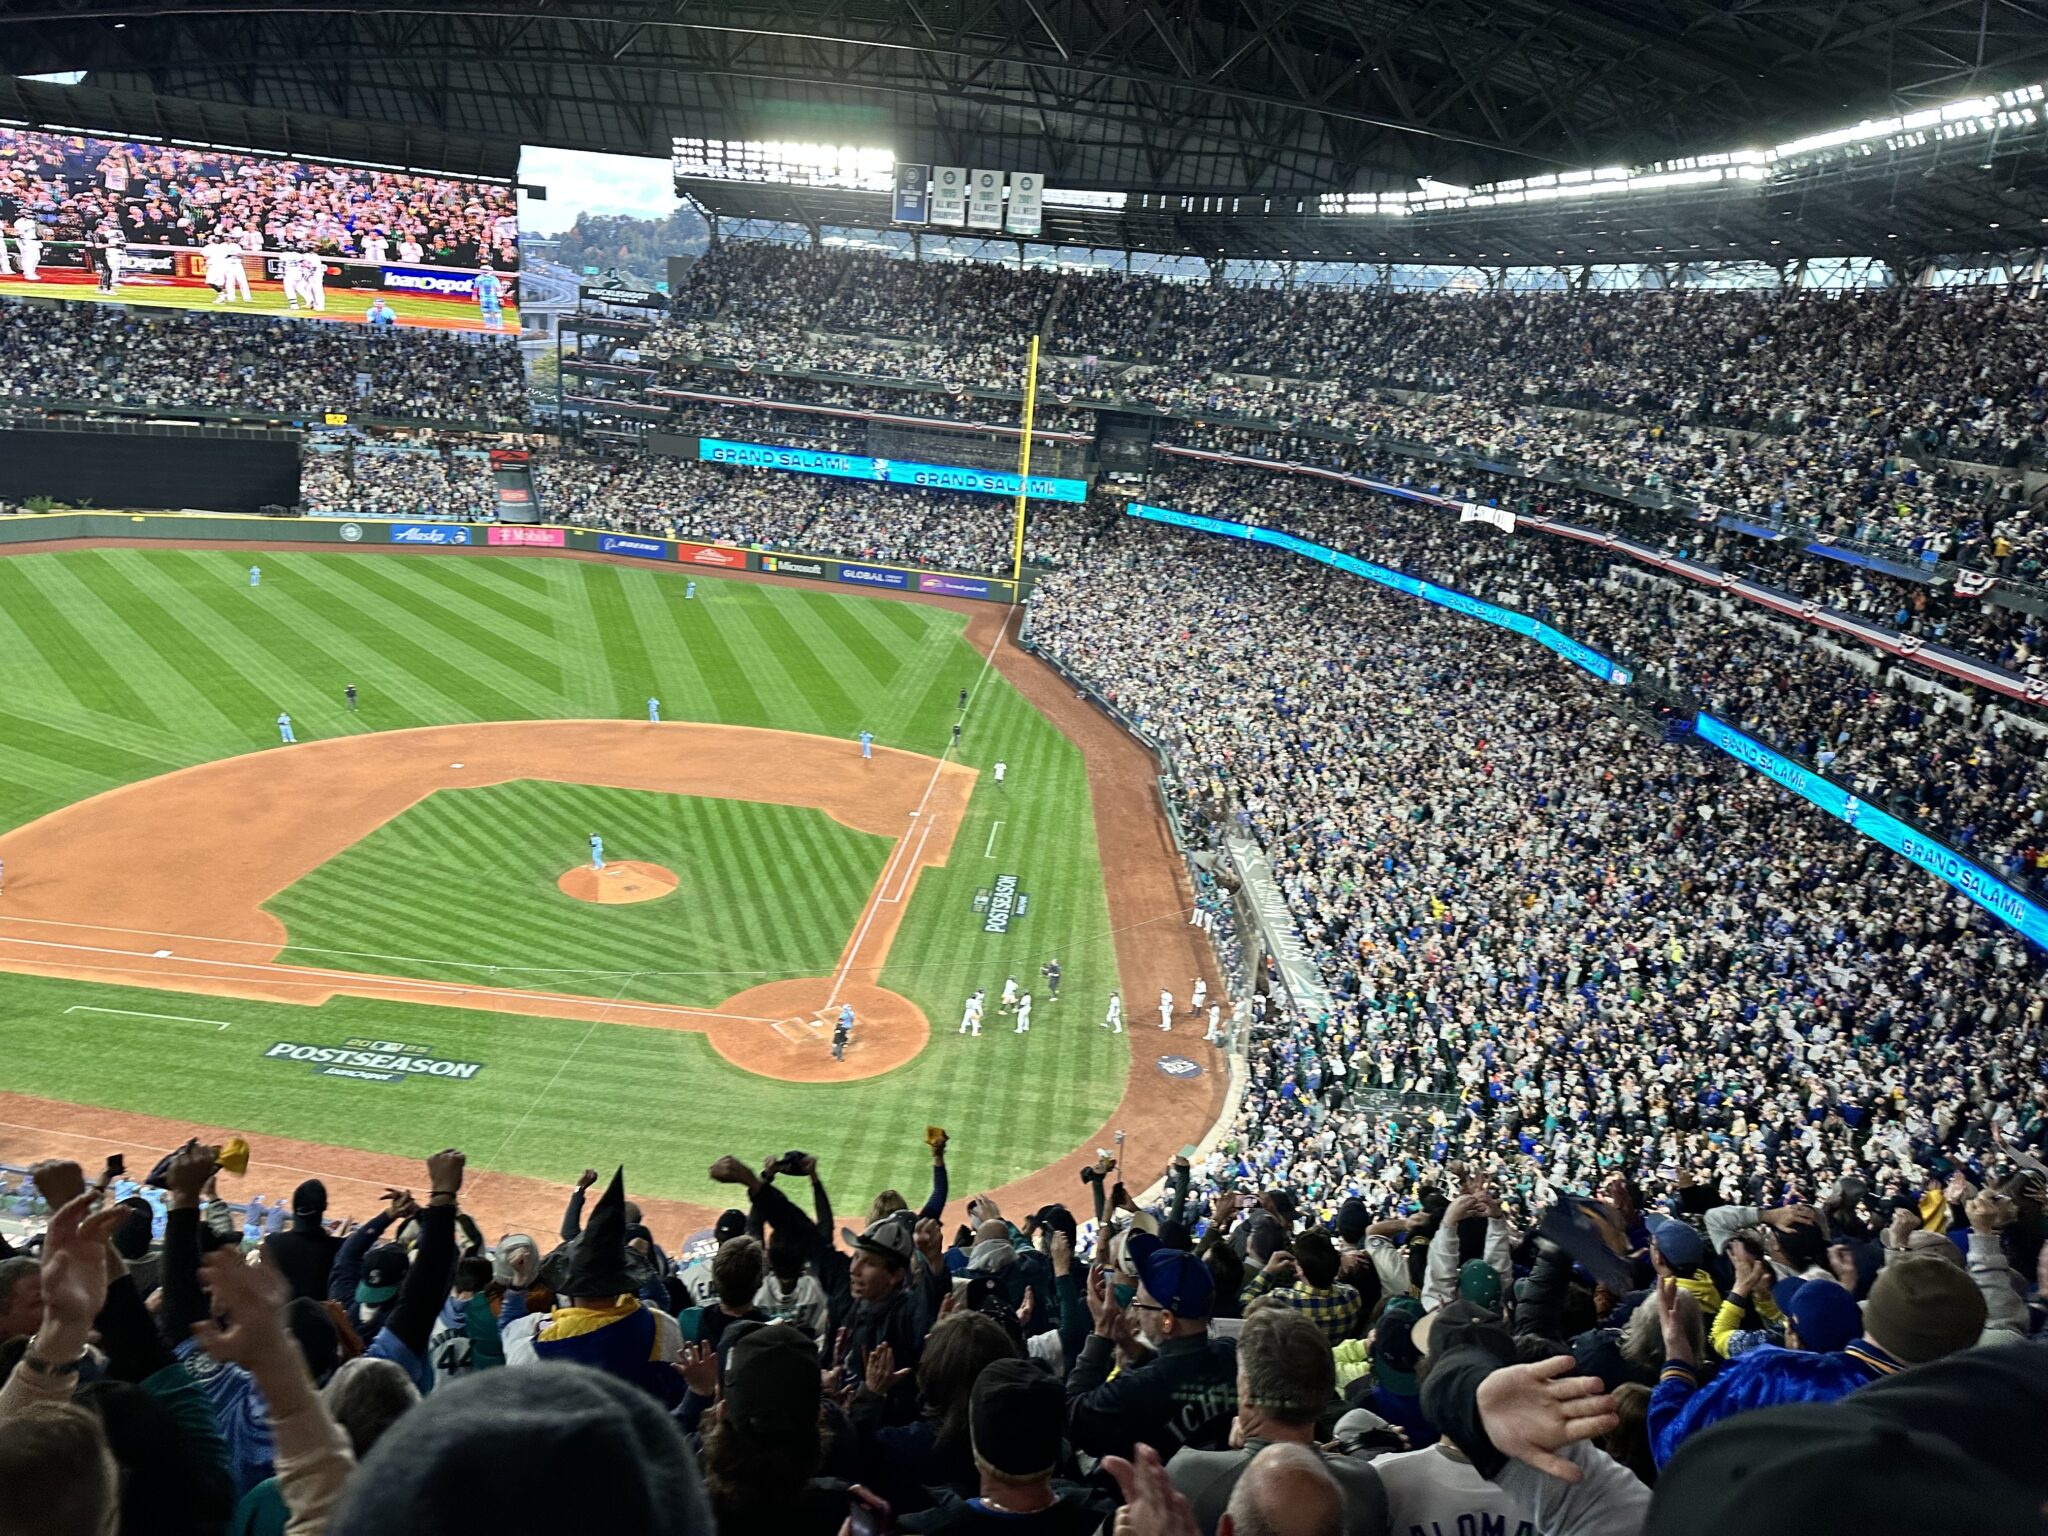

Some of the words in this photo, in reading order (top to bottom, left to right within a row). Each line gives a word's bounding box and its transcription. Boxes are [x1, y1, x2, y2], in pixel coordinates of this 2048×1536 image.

[713, 448, 774, 463] GRAND
[914, 472, 977, 487] GRAND
[396, 528, 447, 543] Alaska
[617, 541, 660, 551] BOEING
[778, 561, 821, 574] Microsoft
[843, 569, 885, 582] GLOBAL
[1720, 731, 1758, 762] GRAND
[1901, 838, 1959, 878] GRAND
[984, 875, 1018, 933] POSTSEASON
[265, 1042, 480, 1078] POSTSEASON
[323, 1067, 393, 1080] loanDepot
